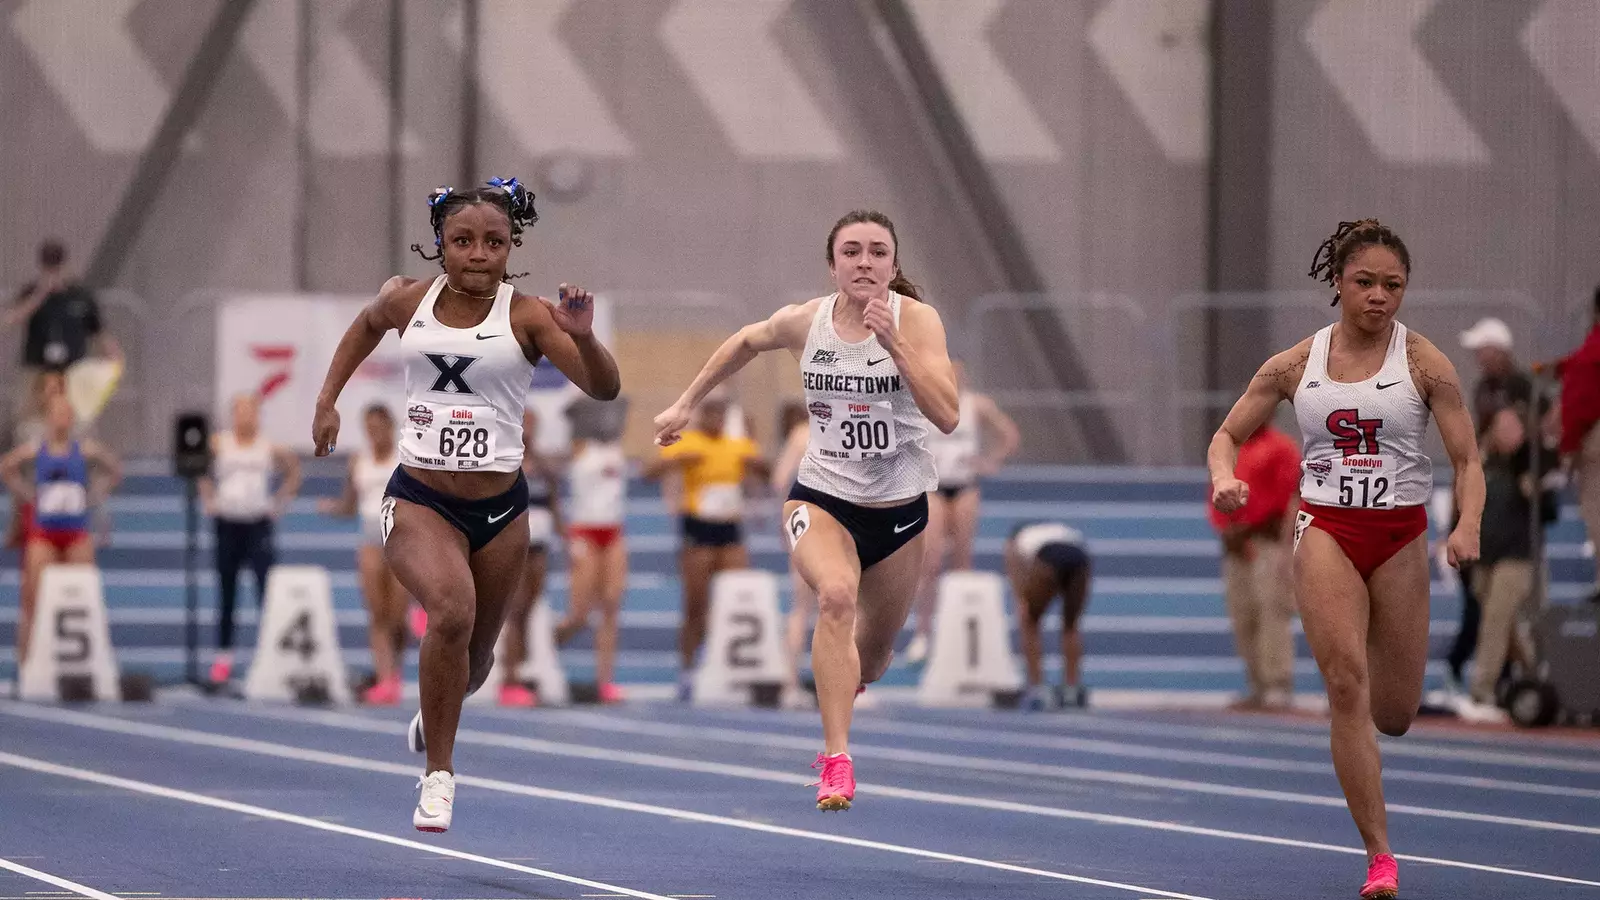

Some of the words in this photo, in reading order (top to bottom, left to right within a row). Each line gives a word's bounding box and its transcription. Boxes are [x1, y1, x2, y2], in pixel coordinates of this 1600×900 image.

[811, 356, 842, 364] EAST
[816, 349, 837, 357] BIG
[418, 351, 483, 396] X
[803, 371, 901, 394] GEORGETOWN
[452, 409, 473, 419] Laila
[848, 403, 871, 413] Piper
[439, 427, 489, 458] 628
[840, 420, 889, 450] 300
[434, 458, 446, 466] TAG
[838, 451, 850, 459] TAG
[1342, 456, 1382, 468] Brooklyn
[1339, 476, 1389, 508] 512
[791, 510, 806, 540] 6
[54, 608, 92, 662] 5
[278, 610, 317, 661] 4
[726, 612, 762, 669] 2
[965, 616, 979, 668] 1
